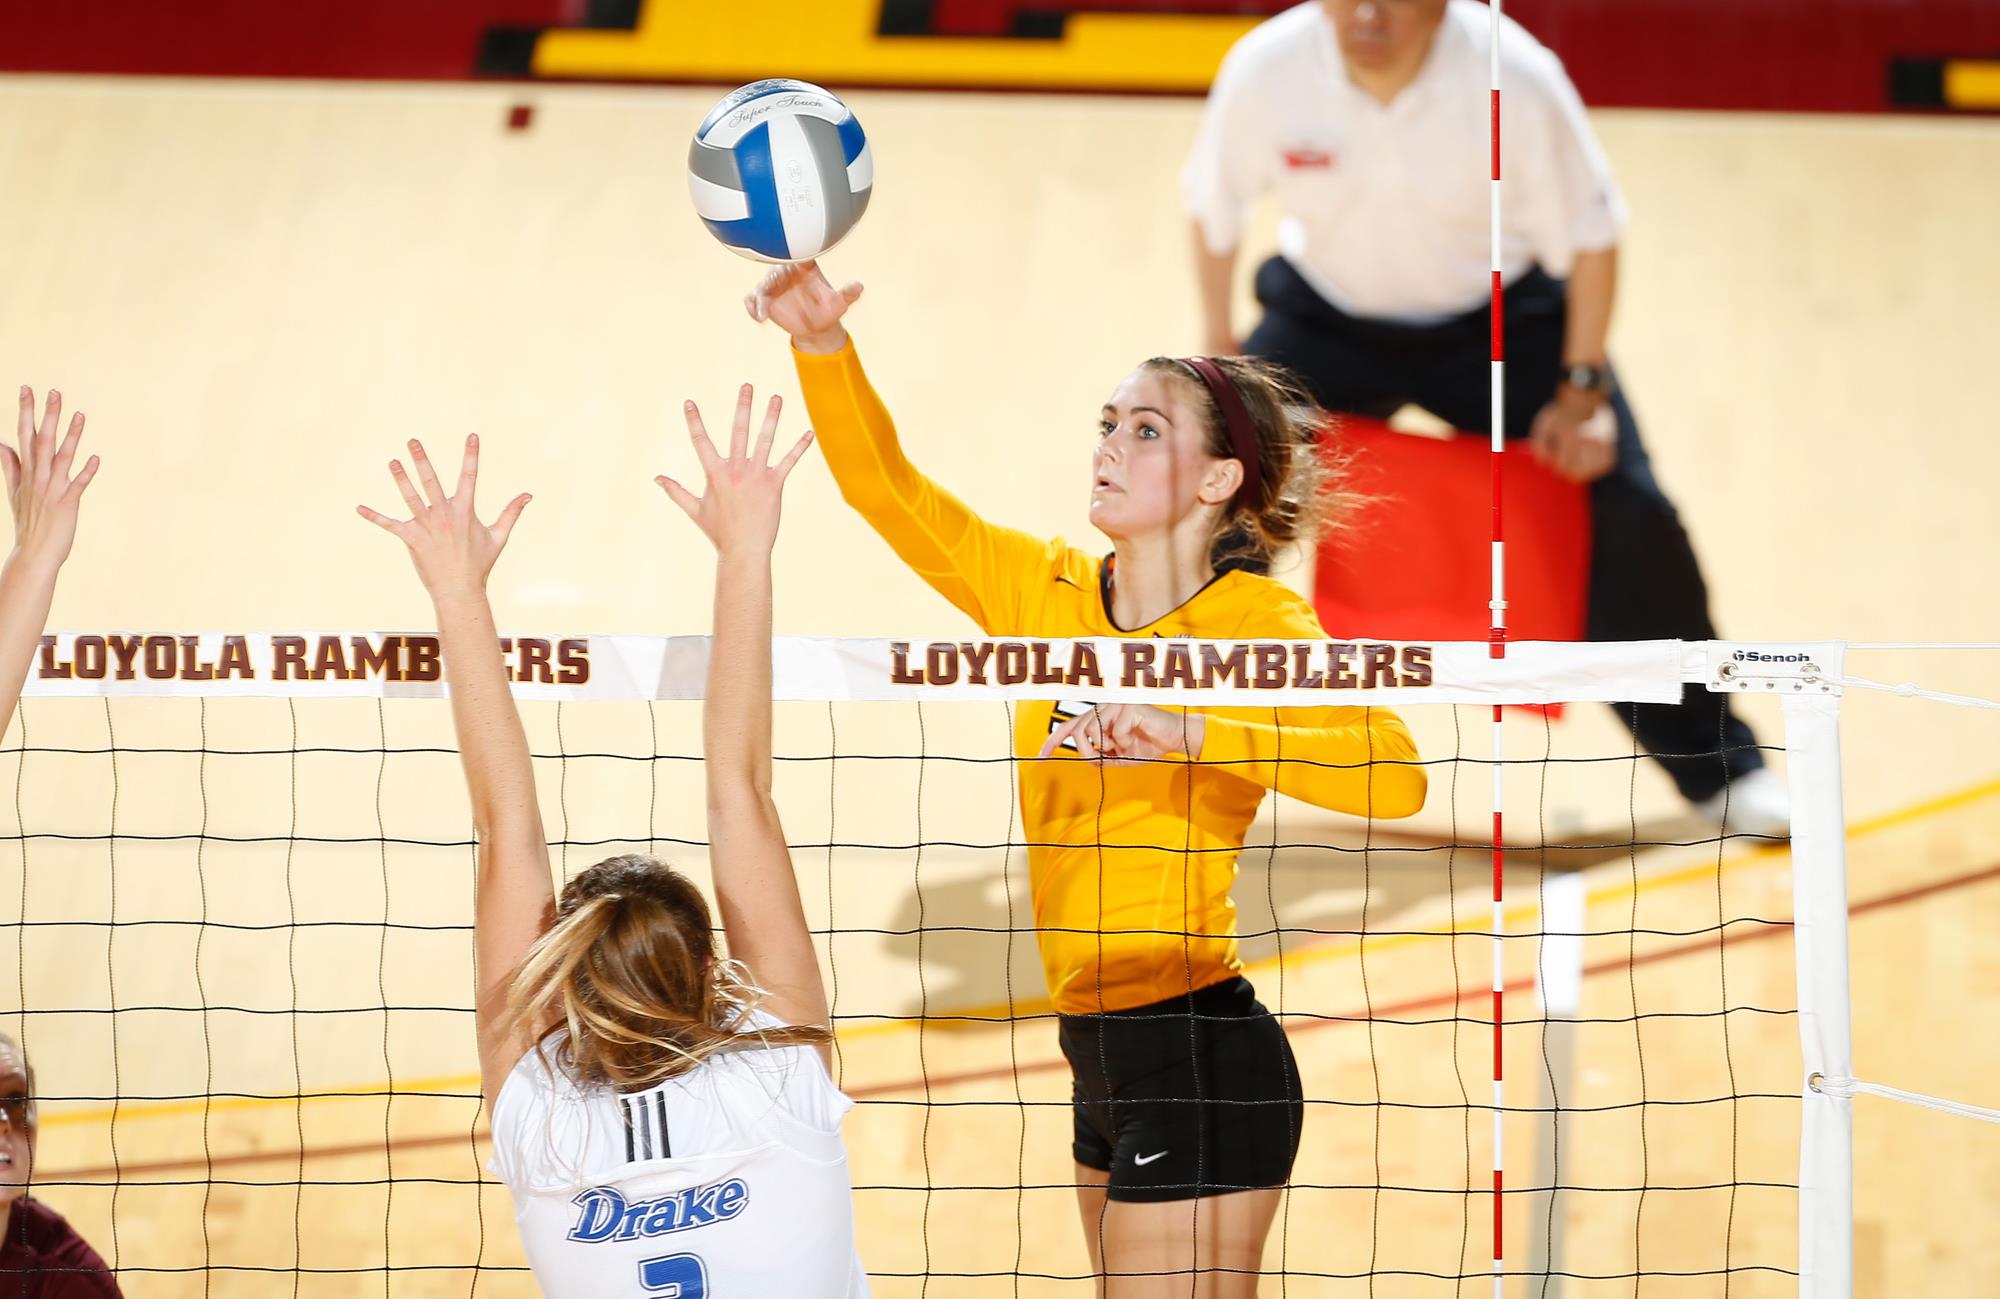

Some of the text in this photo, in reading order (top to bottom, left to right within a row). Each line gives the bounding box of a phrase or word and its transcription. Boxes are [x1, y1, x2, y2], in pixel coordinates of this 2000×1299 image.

[728, 95, 824, 128] Super Touch
[38, 634, 591, 685] LOYOLA RAMBRS
[889, 641, 1433, 690] LOYOLA RAMBLERS
[1745, 651, 1810, 662] Senoh
[566, 1177, 750, 1244] Drake
